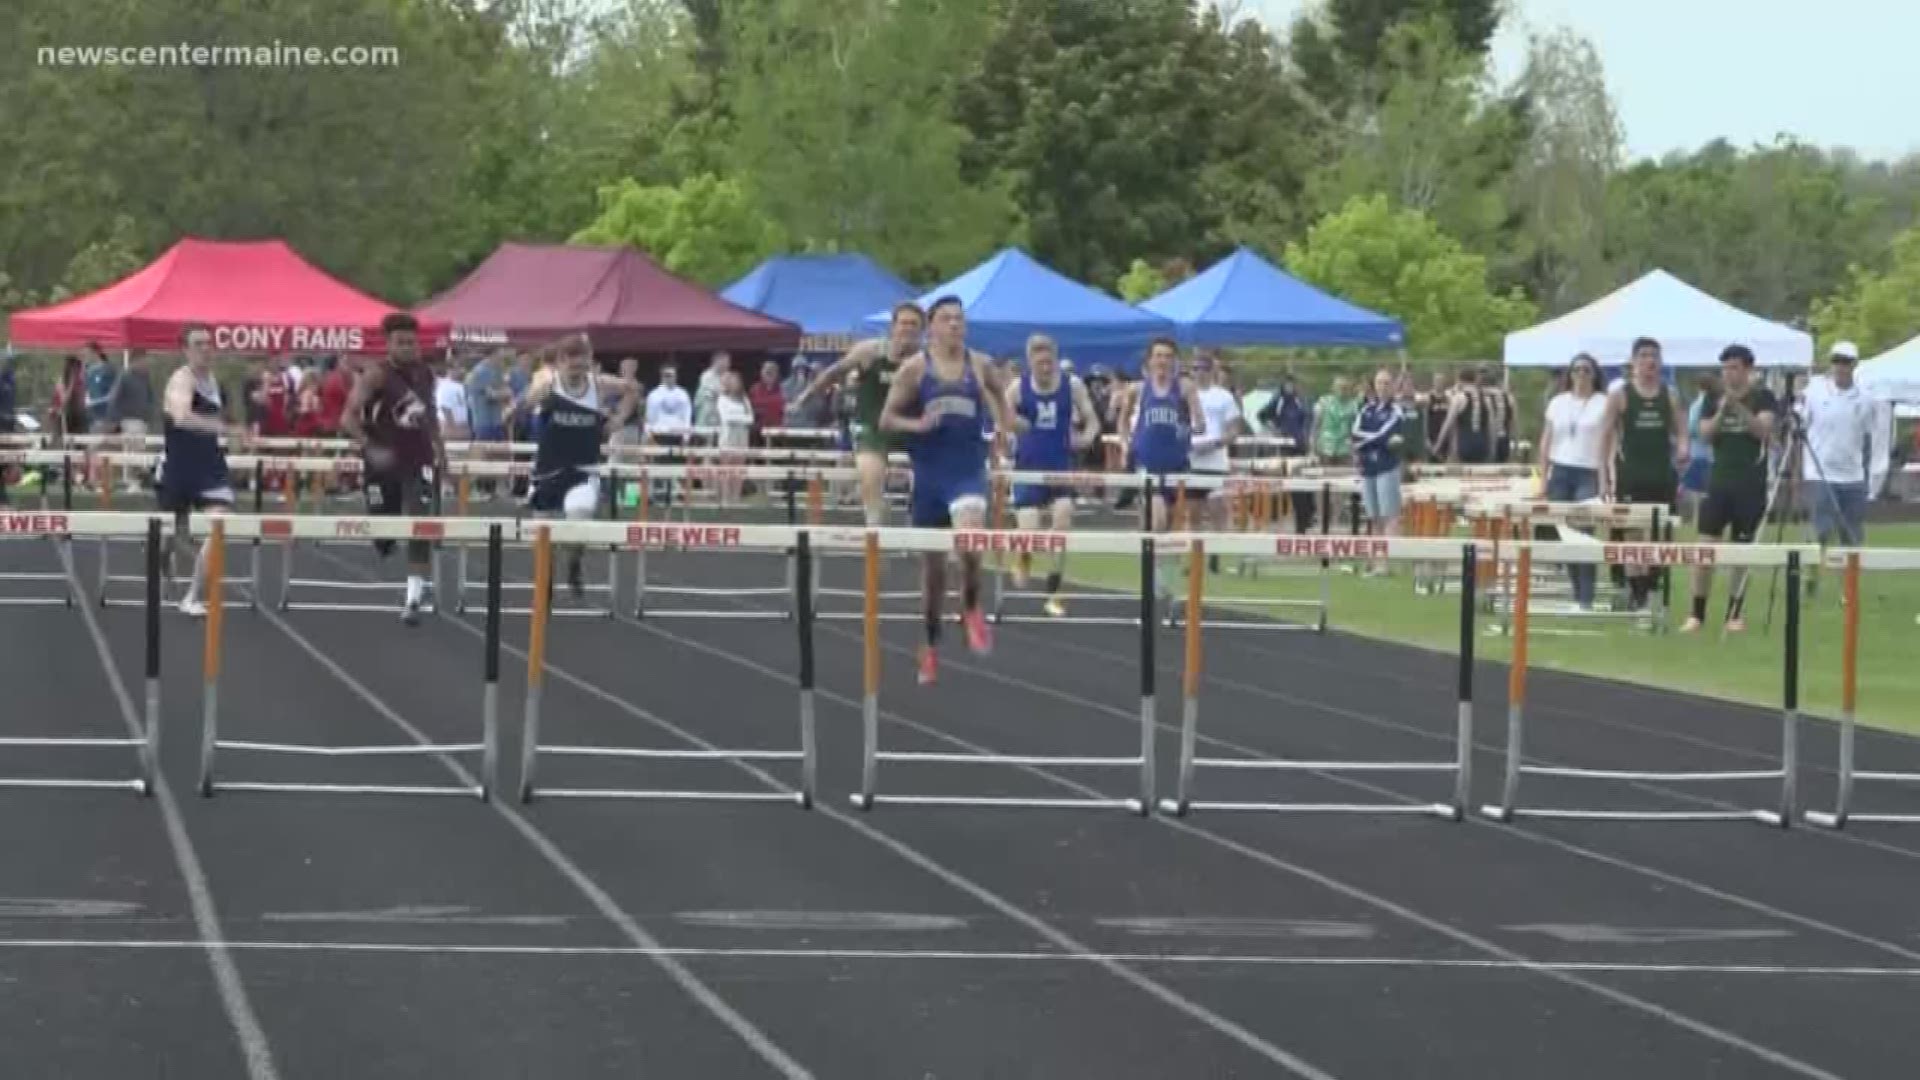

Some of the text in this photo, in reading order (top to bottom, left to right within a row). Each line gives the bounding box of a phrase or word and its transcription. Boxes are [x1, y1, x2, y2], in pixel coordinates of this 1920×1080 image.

[215, 325, 363, 350] CONY RAMS
[626, 526, 740, 546] BREWER
[954, 532, 1067, 552] BREWER
[1276, 538, 1389, 558] BREWER
[1603, 545, 1716, 565] BREWER
